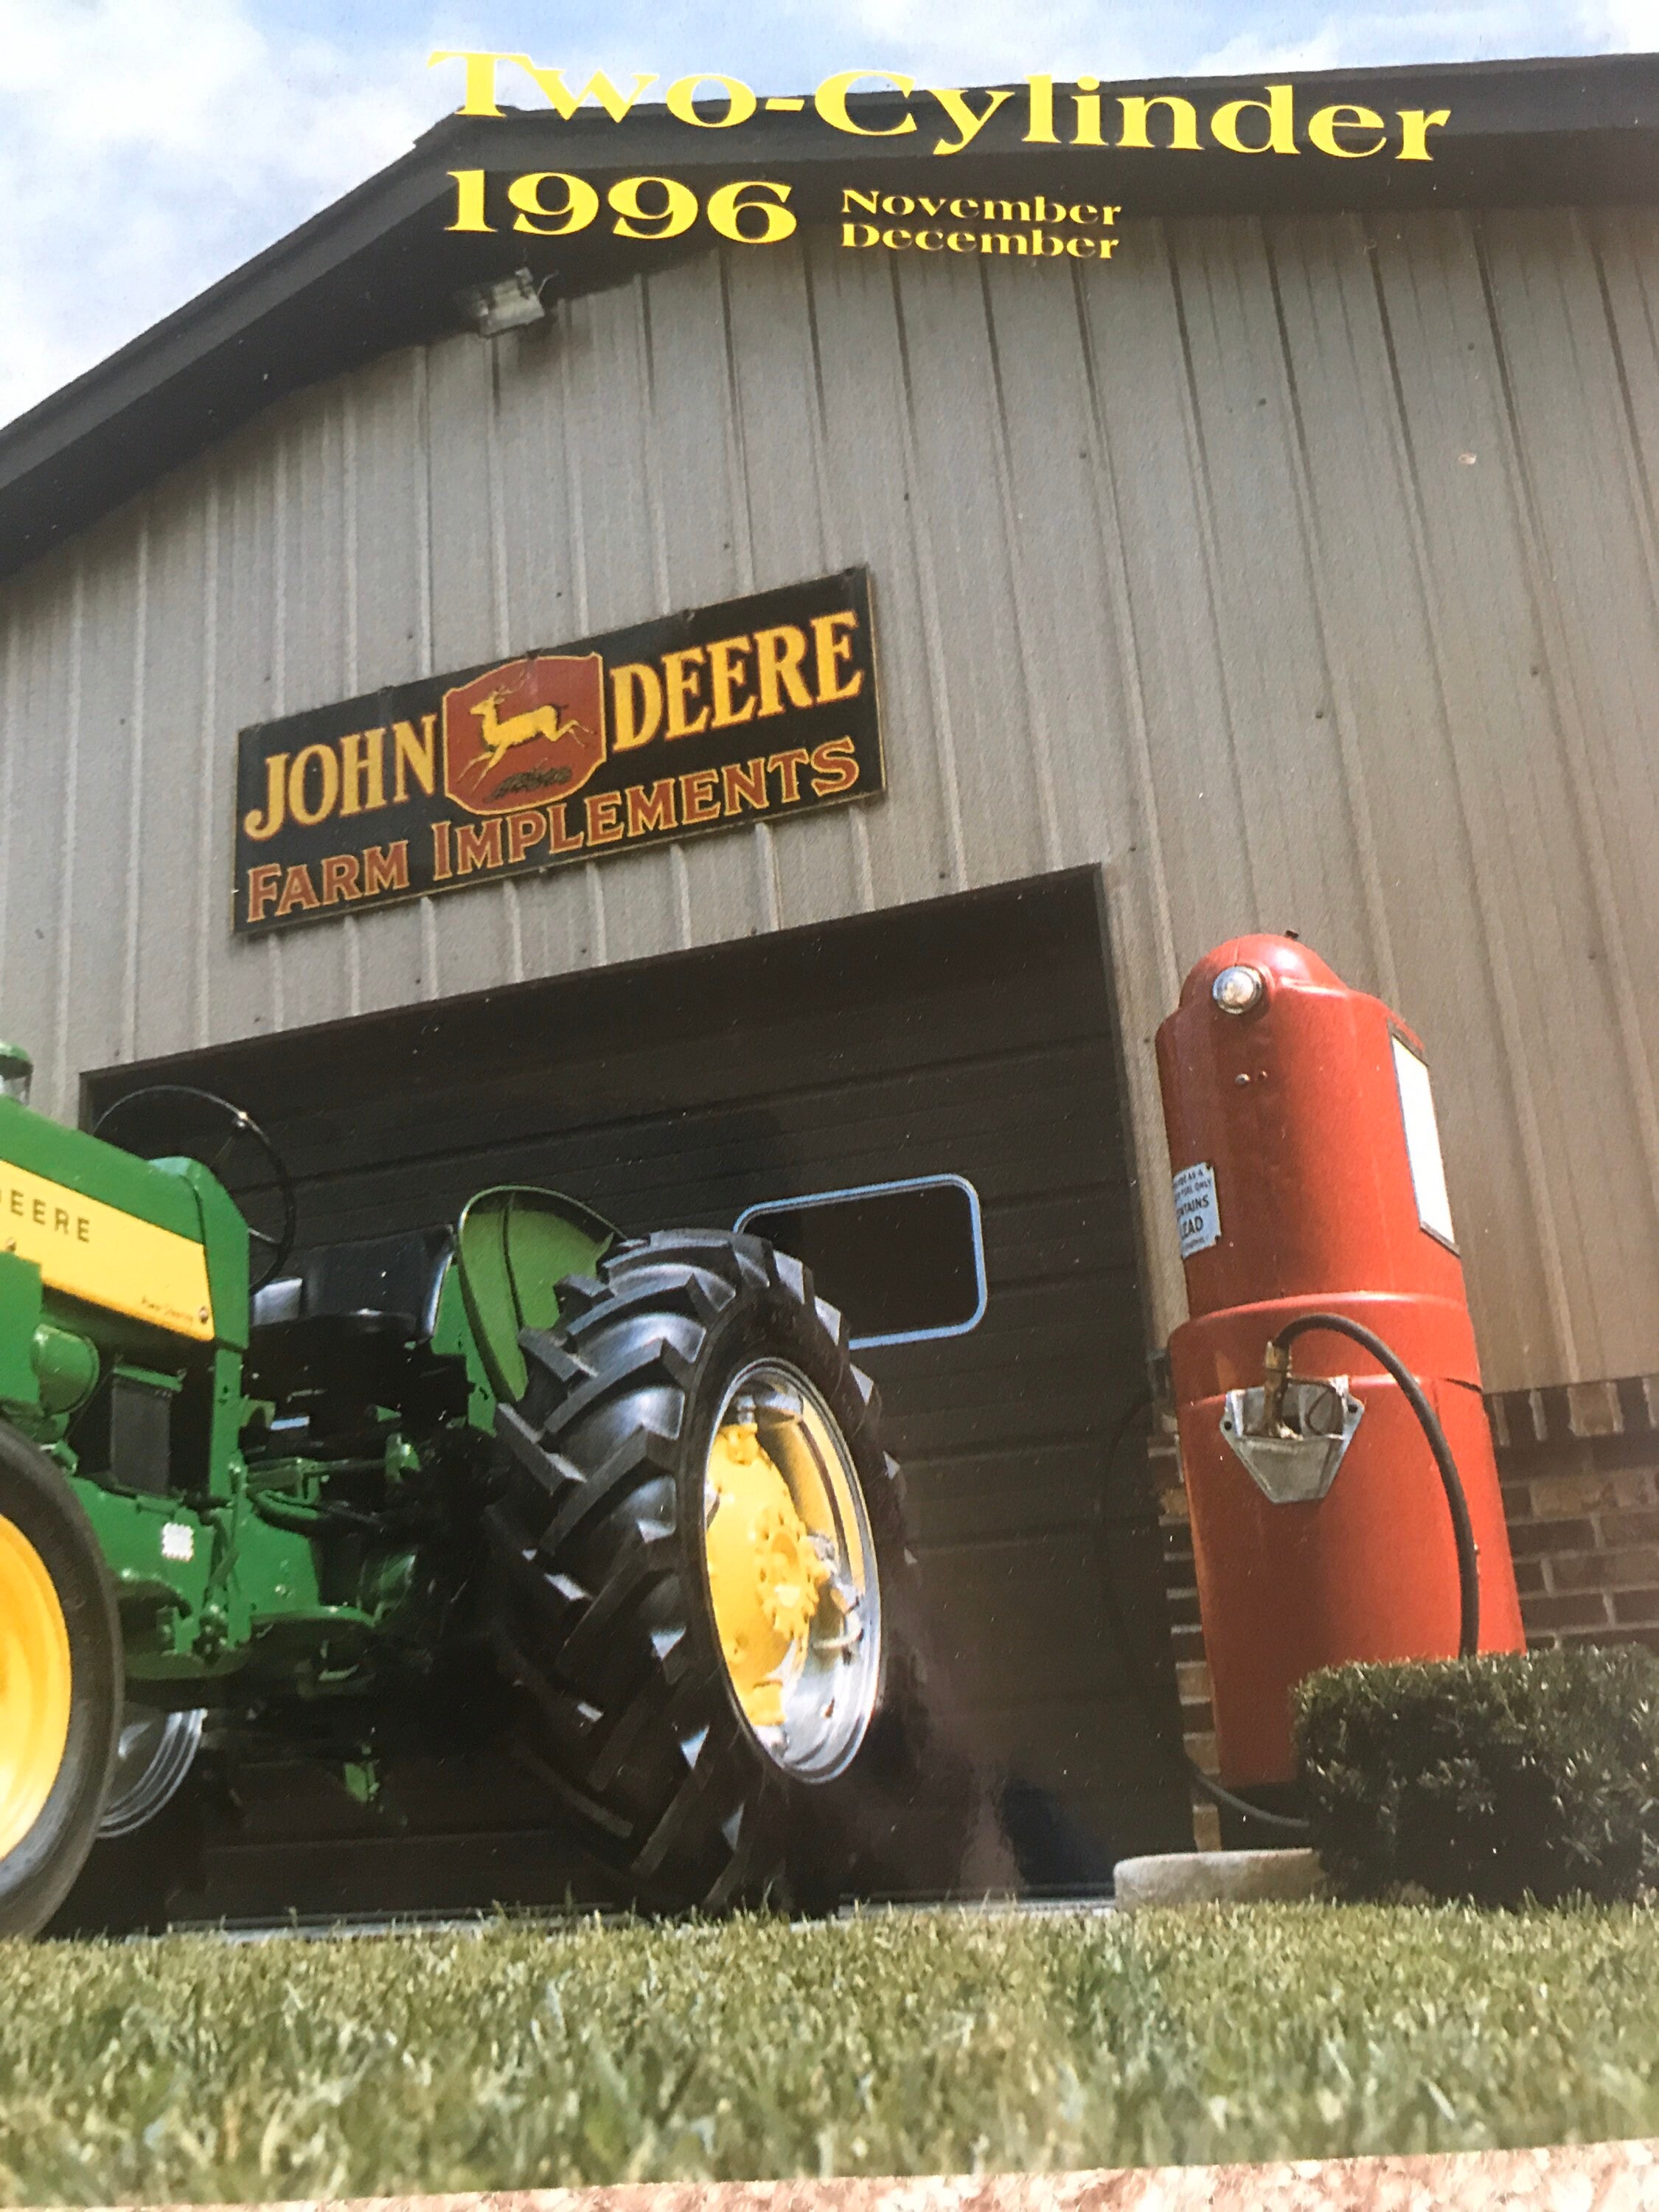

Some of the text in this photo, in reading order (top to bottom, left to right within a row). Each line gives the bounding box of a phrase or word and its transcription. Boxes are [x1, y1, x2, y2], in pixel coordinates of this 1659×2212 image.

[243, 610, 864, 841] JOHN DEERE
[246, 736, 859, 926] FARM IMPLEMENTS
[0, 1186, 90, 1243] EERE
[1194, 1179, 1211, 1192] ONLY
